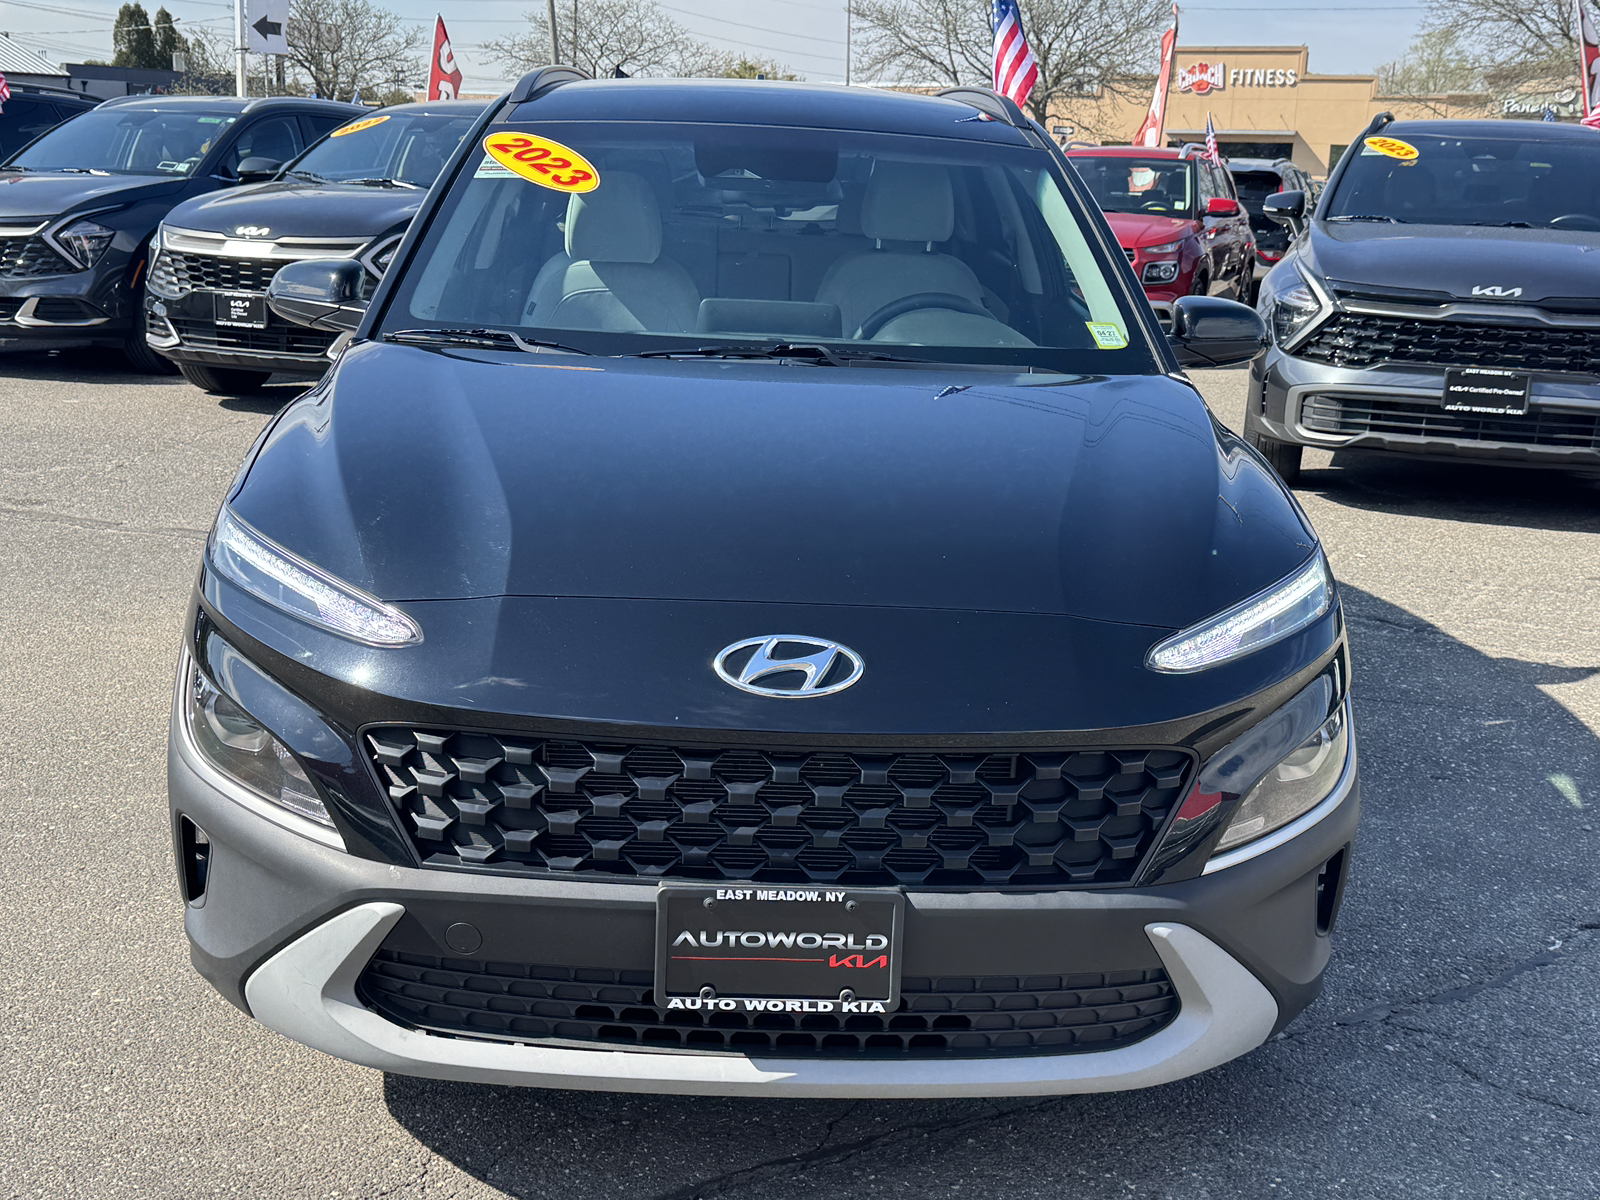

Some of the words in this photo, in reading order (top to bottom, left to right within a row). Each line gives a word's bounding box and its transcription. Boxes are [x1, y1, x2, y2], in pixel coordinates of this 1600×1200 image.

[1178, 62, 1224, 90] CRUNCH
[1230, 69, 1296, 85] FITNESS
[1368, 139, 1415, 156] 2023
[489, 138, 593, 186] 2023
[236, 226, 270, 236] KIA
[1472, 285, 1522, 298] KIA
[1469, 386, 1493, 394] Certified
[1445, 404, 1471, 412] AUTO
[1471, 406, 1506, 414] WORLD
[716, 889, 753, 901] EAST
[825, 892, 845, 902] NY
[672, 930, 888, 950] AUTOWORLD
[829, 953, 888, 969] KIA
[667, 998, 737, 1011] AUTO
[743, 1000, 835, 1013] WORLD
[841, 1002, 887, 1014] KIA
